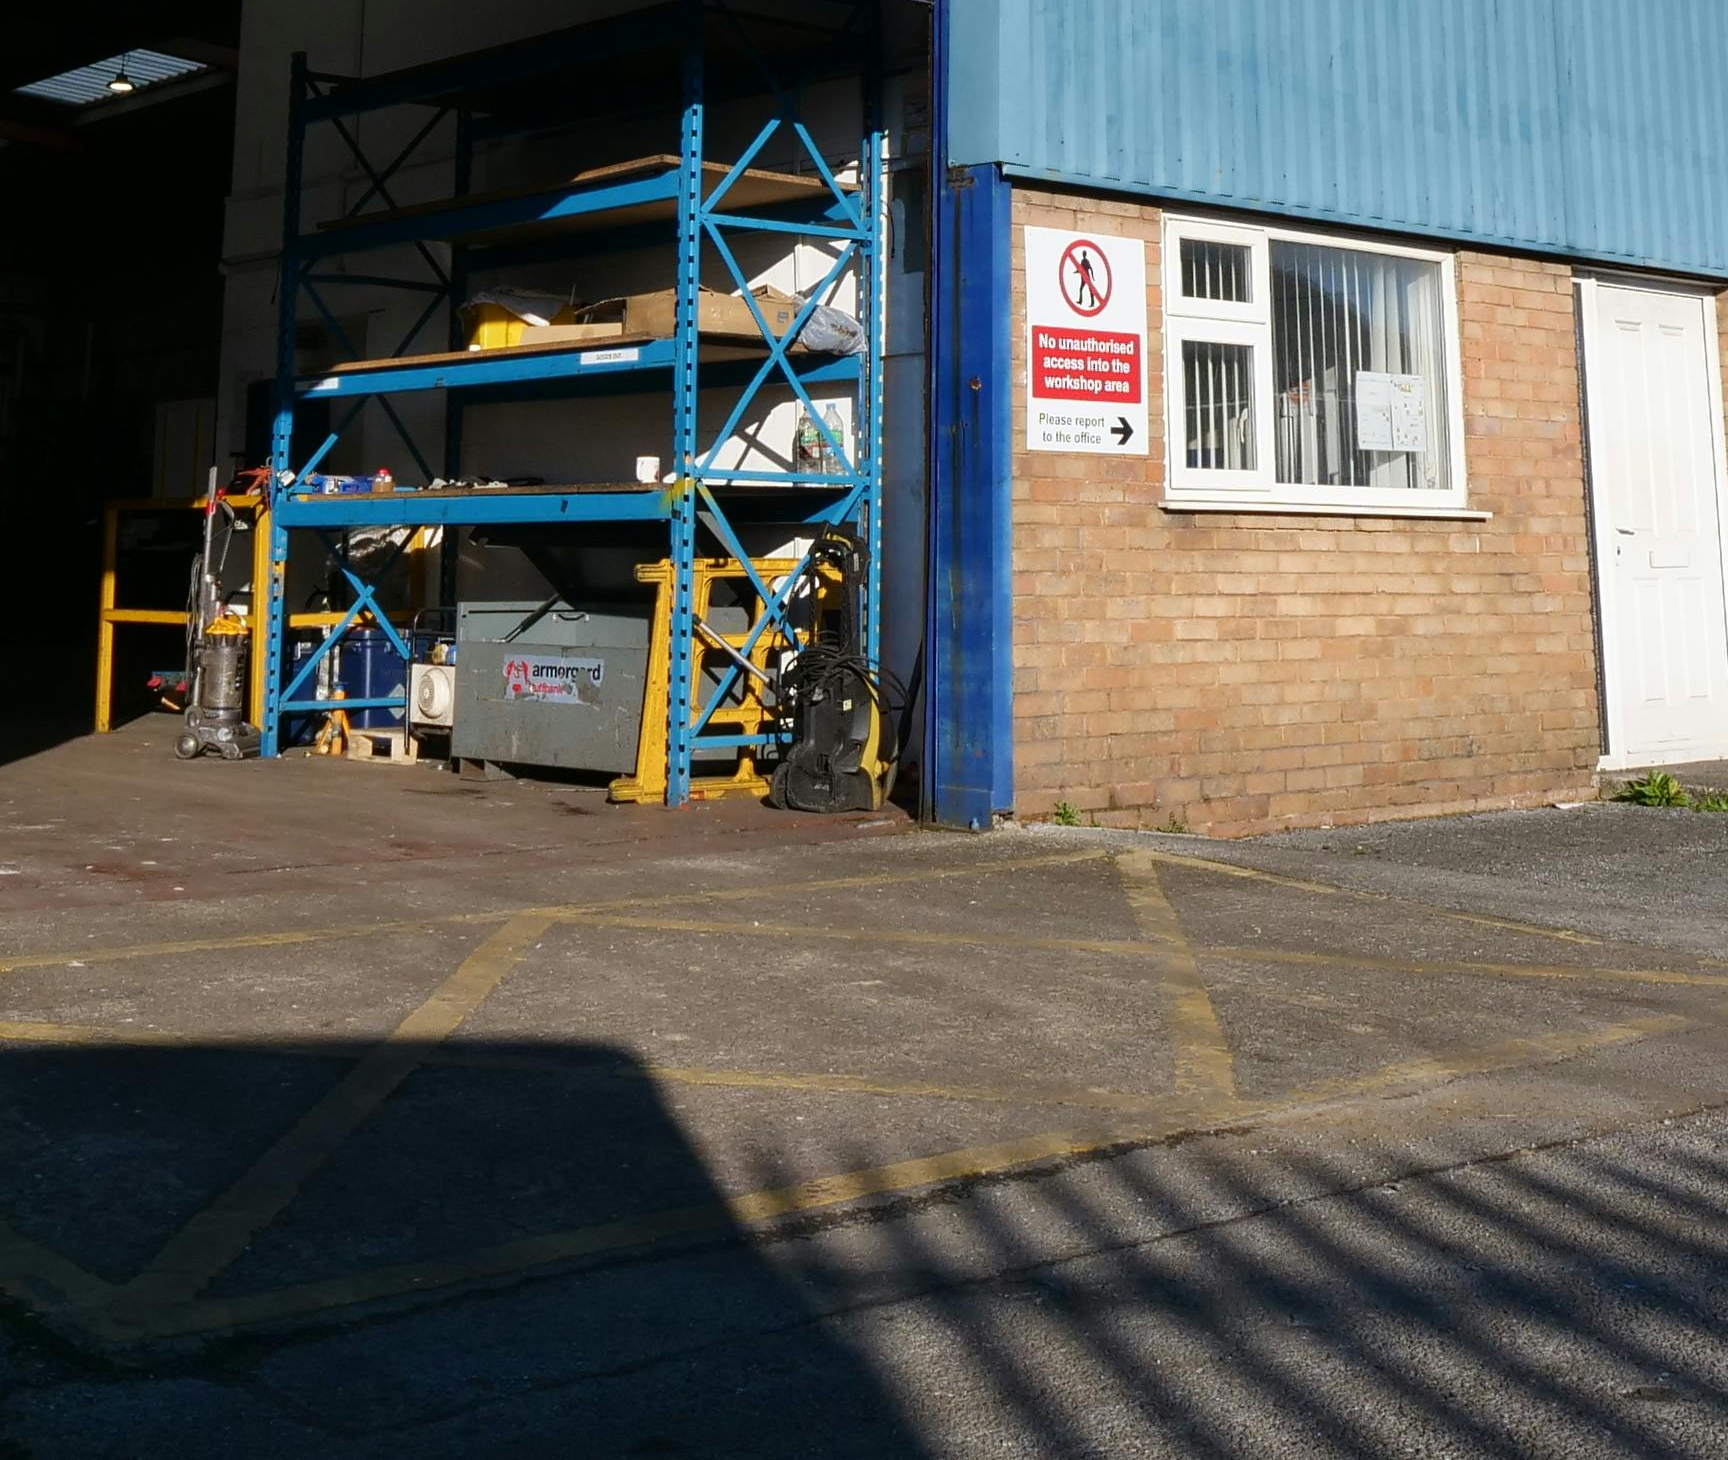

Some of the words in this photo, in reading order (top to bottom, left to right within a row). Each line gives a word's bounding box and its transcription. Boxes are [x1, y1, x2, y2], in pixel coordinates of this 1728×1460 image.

[1038, 333, 1056, 349] No
[1058, 335, 1135, 355] unauthorised
[1043, 356, 1085, 370] access
[1086, 357, 1110, 372] into
[1111, 358, 1131, 374] the
[1044, 375, 1103, 394] workshop
[1104, 380, 1130, 393] area
[1038, 412, 1073, 426] Please
[1075, 415, 1105, 429] report
[1043, 431, 1052, 443] to
[1055, 431, 1072, 443] the
[1074, 432, 1102, 445] office
